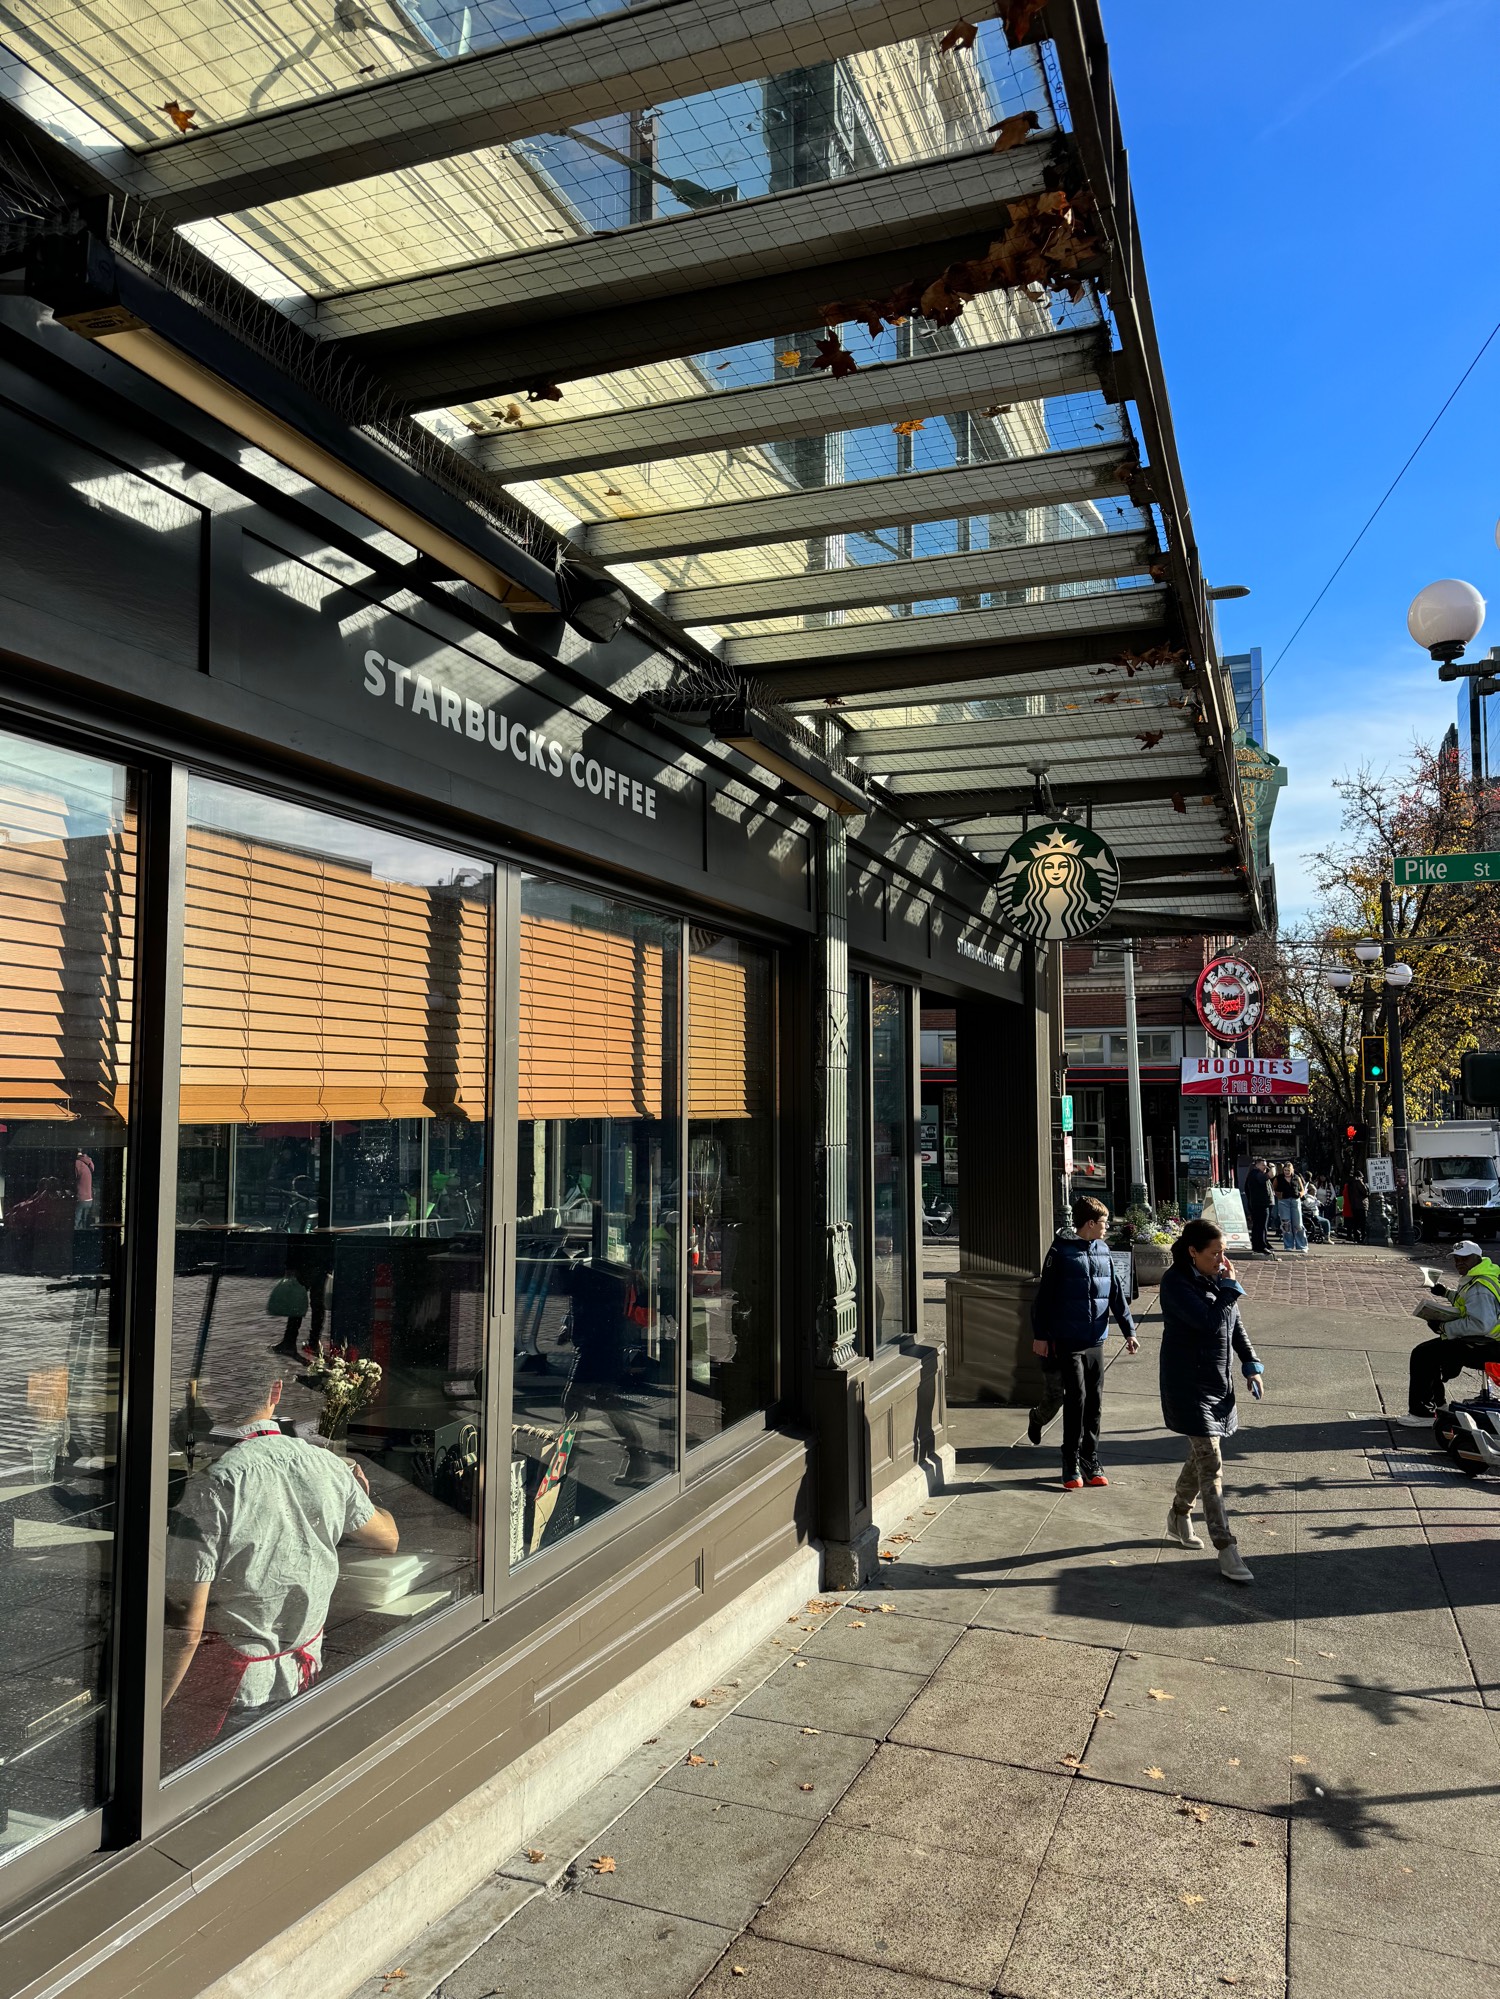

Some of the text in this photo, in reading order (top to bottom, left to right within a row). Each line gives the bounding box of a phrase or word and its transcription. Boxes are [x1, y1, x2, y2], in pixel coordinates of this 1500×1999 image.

[364, 650, 657, 820] STARBUCKS COFFEE
[1405, 860, 1490, 880] Pike St
[1203, 961, 1258, 995] SEATTLE
[1203, 1003, 1243, 1034] SHIRT
[1197, 1059, 1293, 1074] HOODIES
[1221, 1075, 1272, 1094] 2 FOR $25
[1232, 1105, 1306, 1115] SMOKE PLUS
